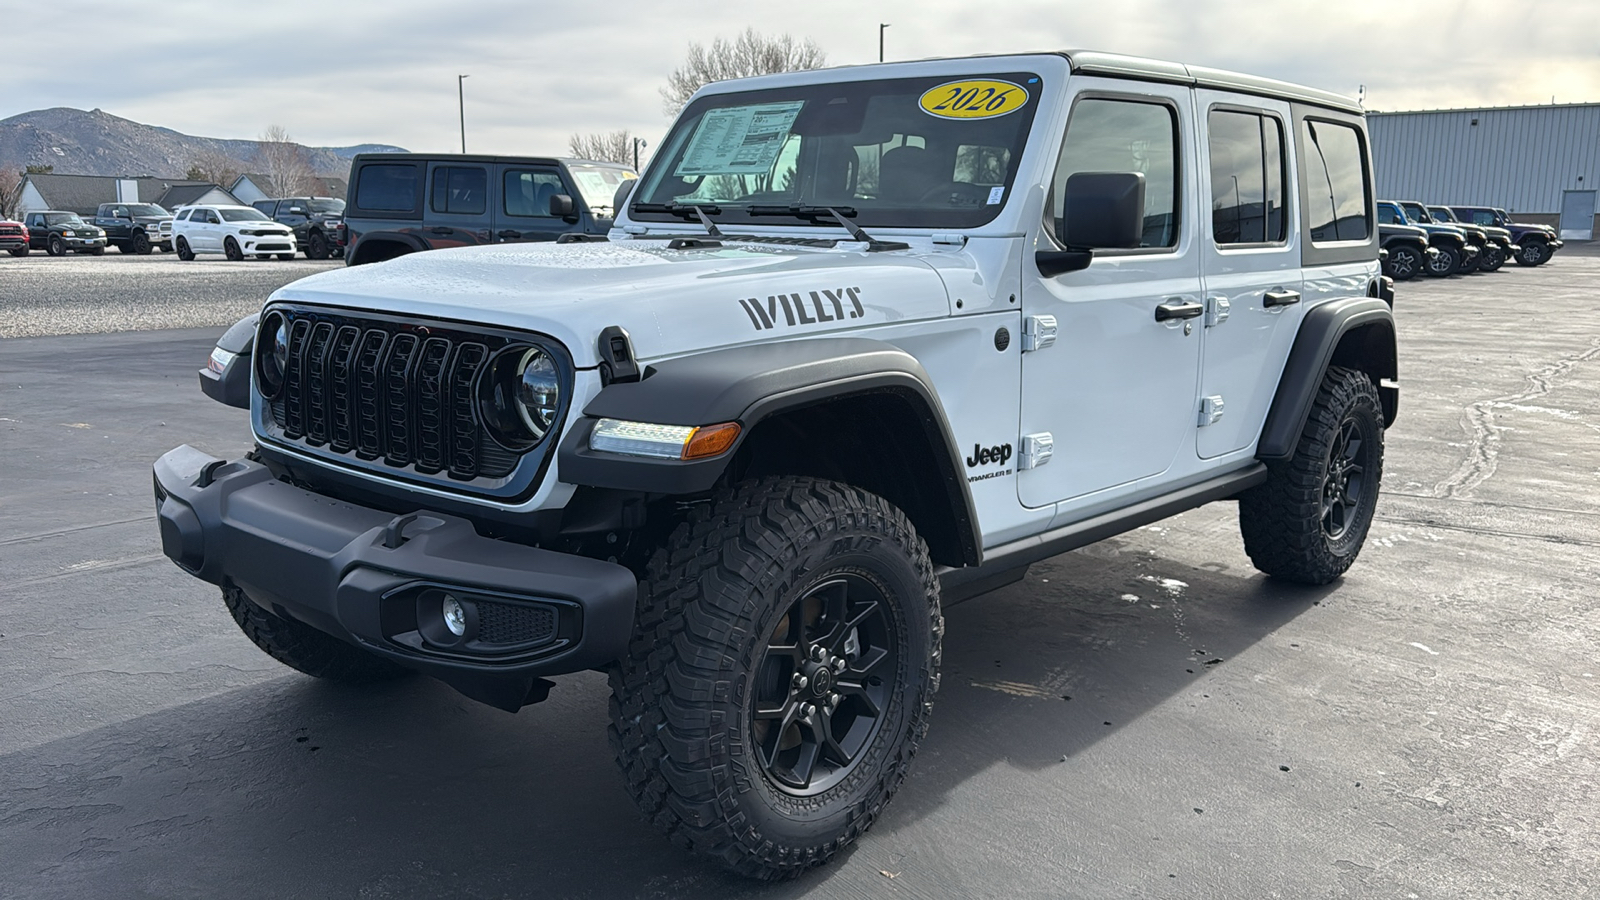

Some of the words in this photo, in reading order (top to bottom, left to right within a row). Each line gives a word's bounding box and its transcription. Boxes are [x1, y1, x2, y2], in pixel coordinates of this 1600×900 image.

[932, 87, 1017, 111] 2026
[738, 286, 865, 331] WILLYS
[966, 443, 1012, 468] Jeep
[728, 554, 812, 794] WILDPEAK
[827, 535, 883, 559] M/T
